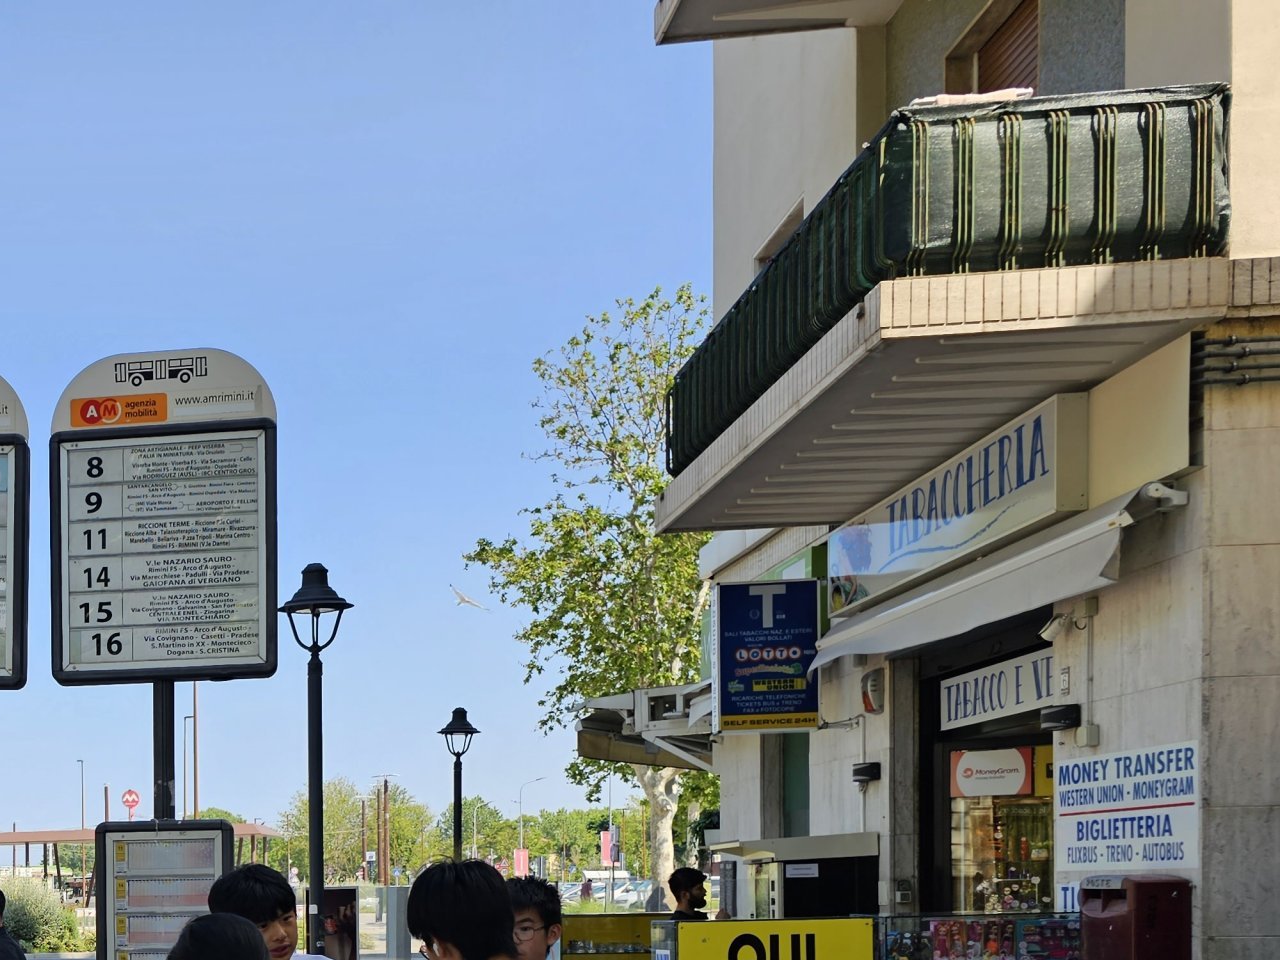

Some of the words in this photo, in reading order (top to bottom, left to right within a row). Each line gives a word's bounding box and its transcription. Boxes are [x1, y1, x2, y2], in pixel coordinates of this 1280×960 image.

[125, 399, 156, 409] agenzia
[175, 390, 255, 406] www.amrimini.it
[125, 409, 157, 418] mobilità
[86, 456, 104, 478] 8
[143, 472, 176, 480] RODRIGUEZ
[886, 415, 1049, 556] TABACCHERIA
[85, 491, 102, 514] 9
[83, 528, 107, 550] 11
[83, 566, 110, 588] 14
[141, 572, 181, 580] Marecchiese
[199, 563, 232, 571] d'Augusto
[143, 579, 186, 587] GAIOFANA
[198, 576, 241, 584] VERGIANO
[79, 601, 113, 624] 15
[749, 584, 786, 628] T
[91, 632, 123, 656] 16
[736, 647, 801, 661] LOTTO
[944, 670, 1008, 723] TABACCO
[1014, 665, 1024, 705] E
[1058, 759, 1109, 786] MONEY
[1114, 747, 1195, 779] TRANSFER
[1059, 787, 1094, 807] WESTERN
[1097, 784, 1124, 804] UNION
[1133, 776, 1194, 800] MONEYGRAM
[1077, 814, 1173, 842] BIGLIETTERIA
[1067, 846, 1098, 863] FLIXBUS
[1106, 844, 1133, 863] TRENO
[1142, 842, 1185, 861] AUTOBUS
